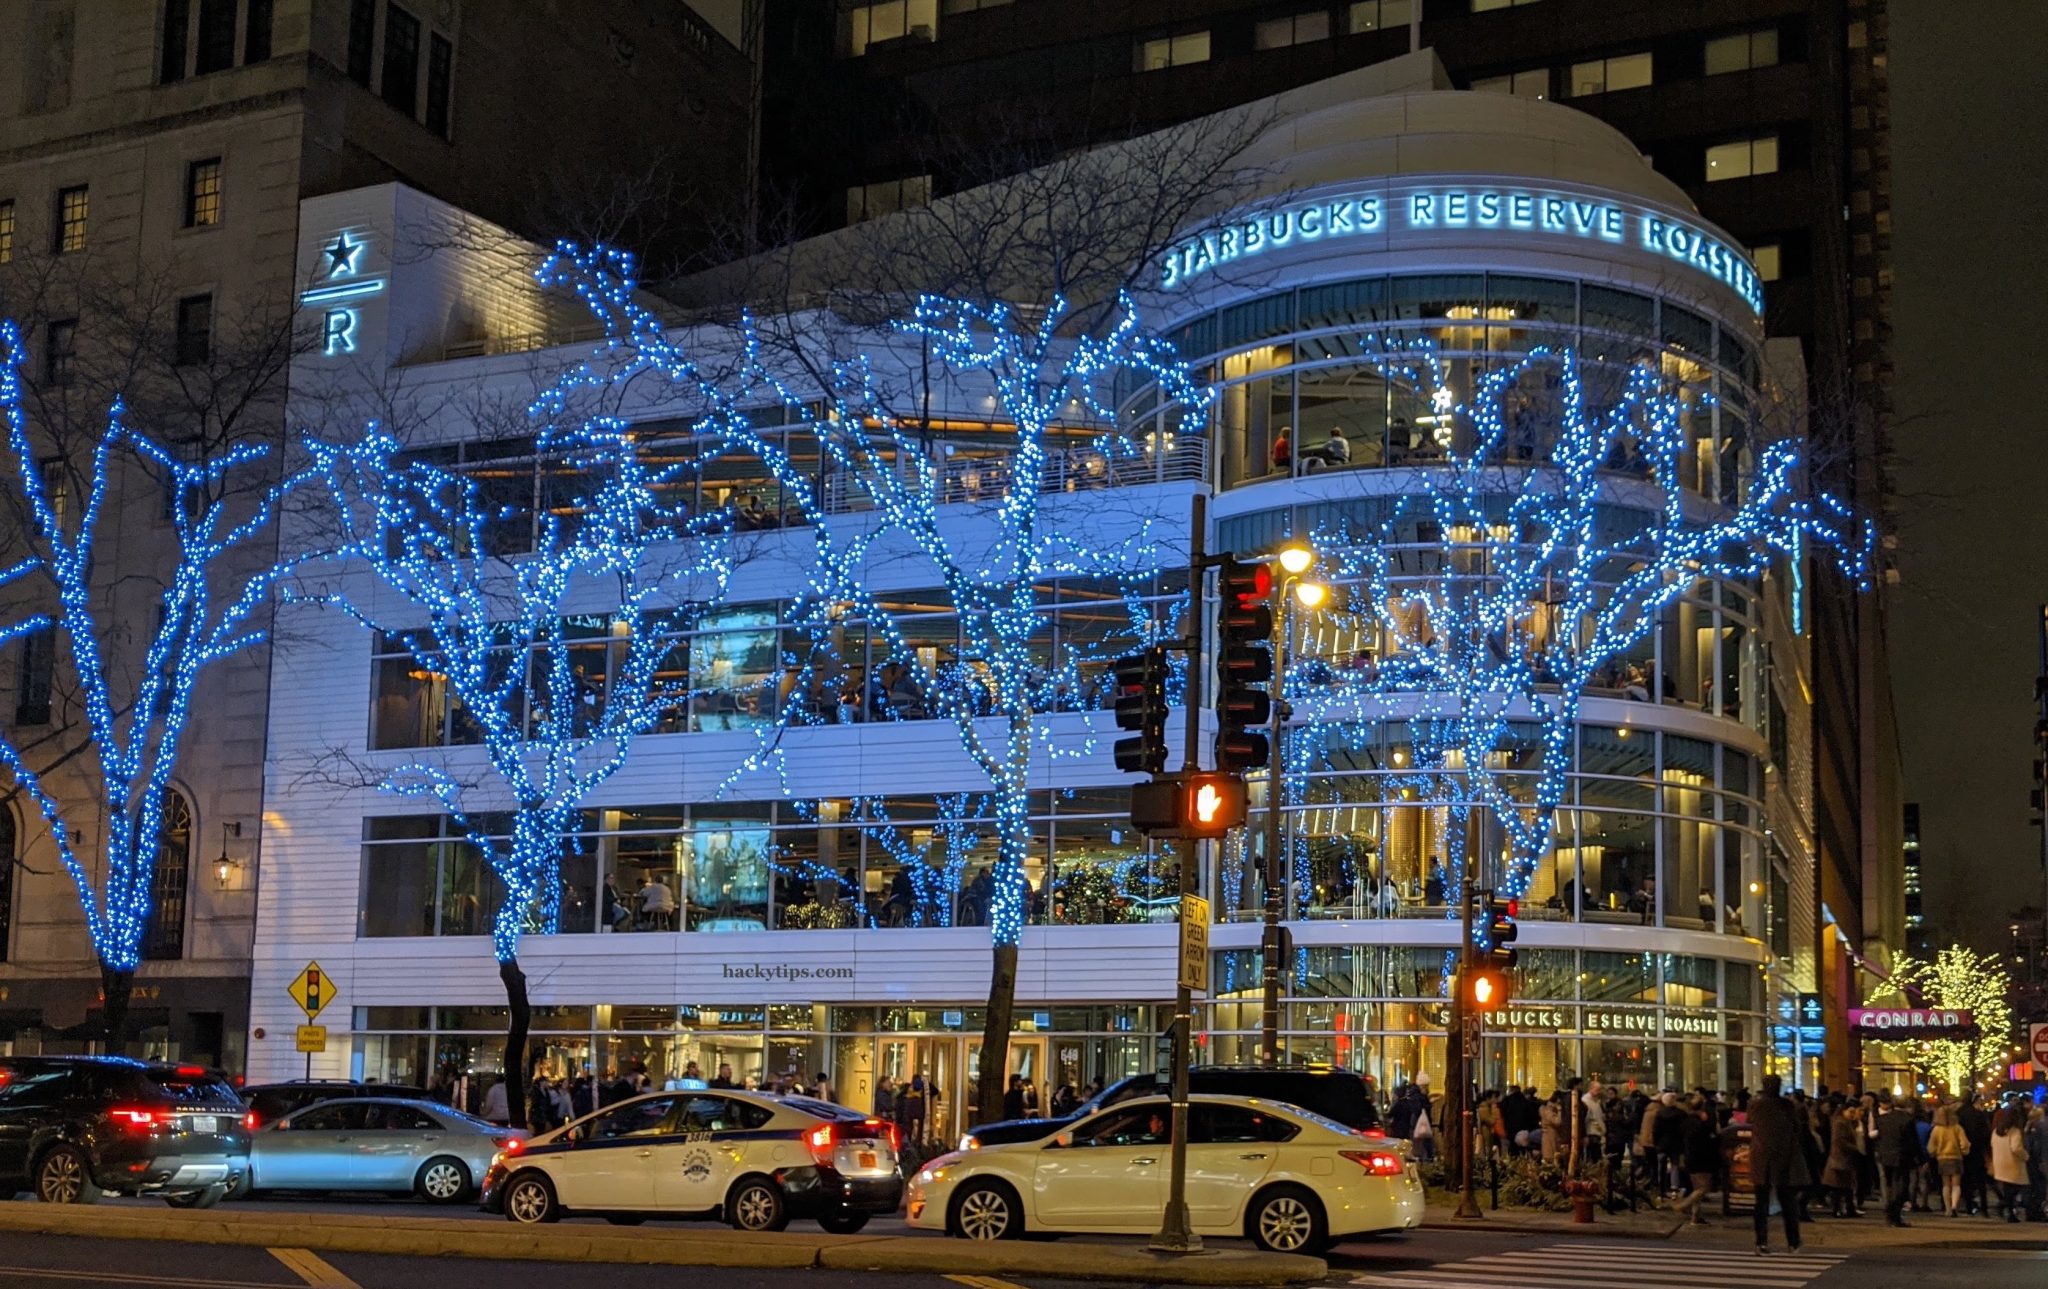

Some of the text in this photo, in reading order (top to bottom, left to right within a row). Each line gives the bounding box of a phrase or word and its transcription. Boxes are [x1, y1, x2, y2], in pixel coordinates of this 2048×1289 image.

[1160, 198, 1379, 287] STARBUCKS
[1412, 193, 1623, 237] RESERVE
[323, 309, 355, 355] R
[1184, 901, 1207, 922] LEFT ON
[1186, 921, 1205, 942] GREEN
[1185, 943, 1205, 962] ARROW
[1187, 963, 1202, 982] ONLY
[1860, 1011, 1960, 1029] CONRAD
[859, 1079, 867, 1094] R
